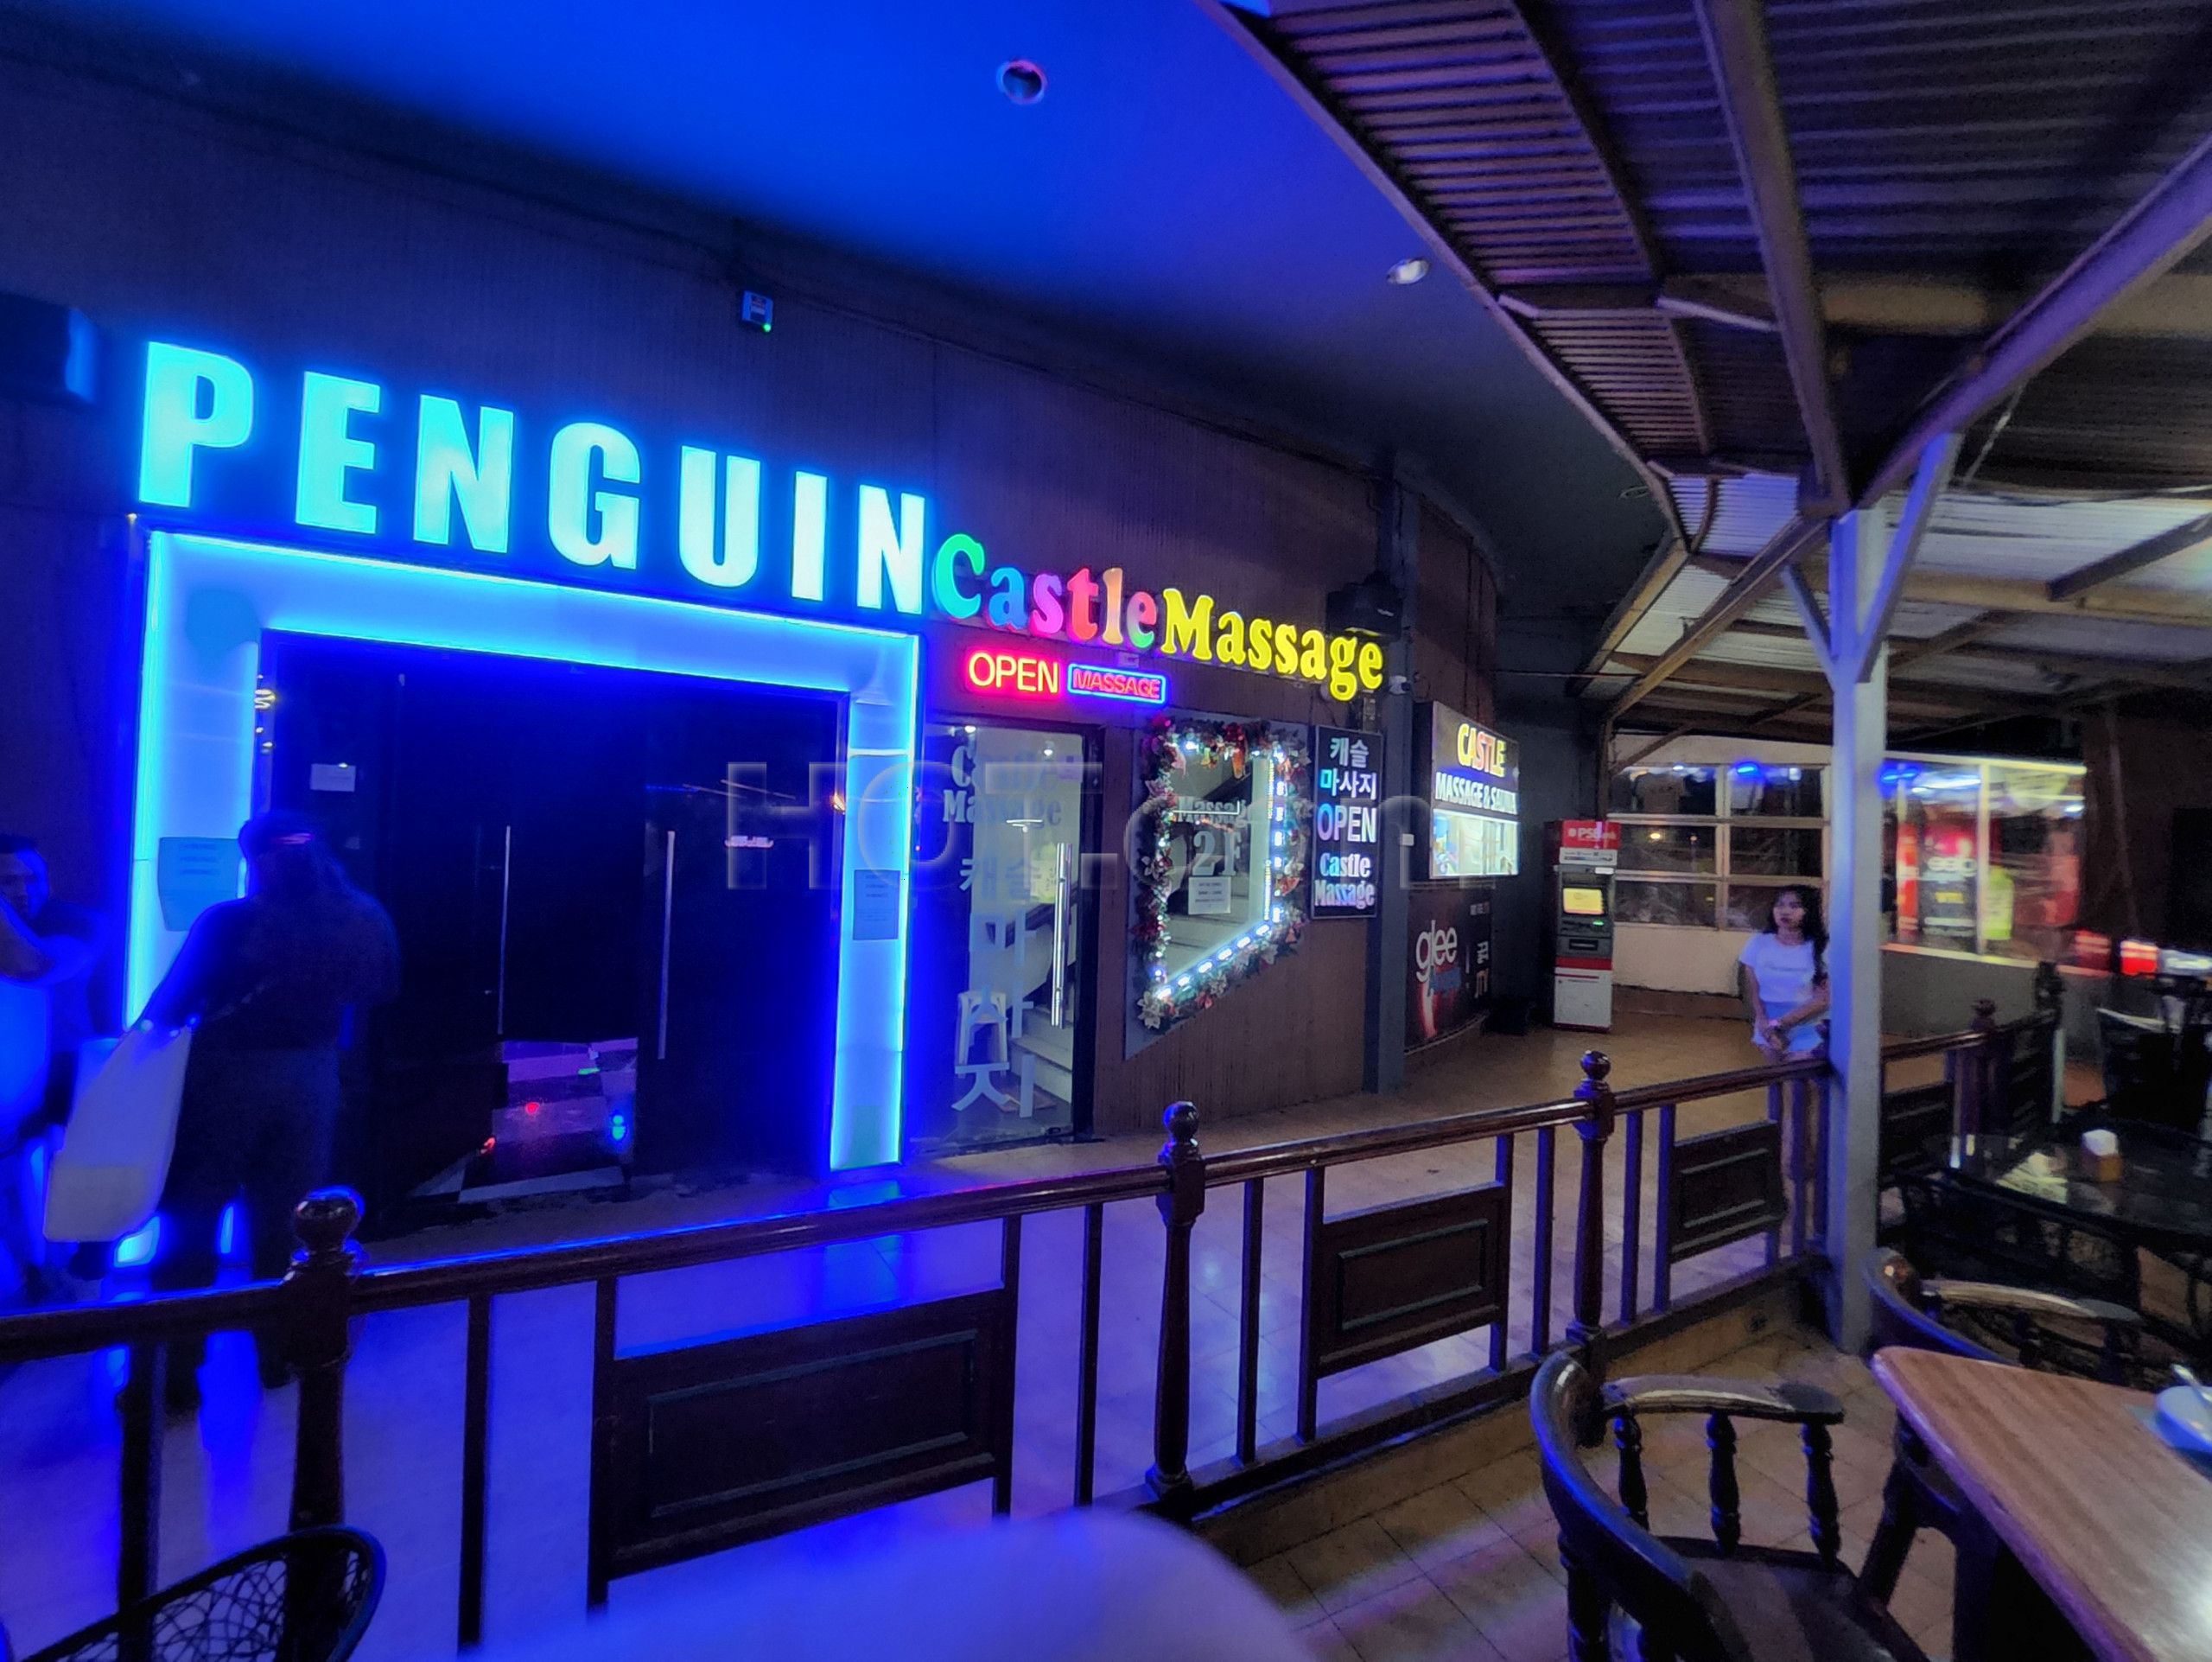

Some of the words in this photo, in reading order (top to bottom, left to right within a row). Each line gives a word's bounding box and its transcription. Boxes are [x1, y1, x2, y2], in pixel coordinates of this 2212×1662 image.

[138, 341, 927, 615] PENGUIN
[933, 533, 1157, 648] Castle
[1161, 588, 1382, 702] Massage
[969, 653, 1058, 693] OPEN
[1072, 669, 1160, 698] MASSAGE
[1330, 737, 1369, 768] 캐슬
[1458, 723, 1506, 777] CASTLE
[1319, 767, 1377, 800] 마사지
[1435, 772, 1484, 808] MASSAGE
[1317, 803, 1377, 843] OPEN
[1192, 831, 1242, 876] 2F
[1319, 853, 1371, 878] Castle
[1314, 880, 1376, 909] Massage
[1415, 920, 1458, 982] glee
